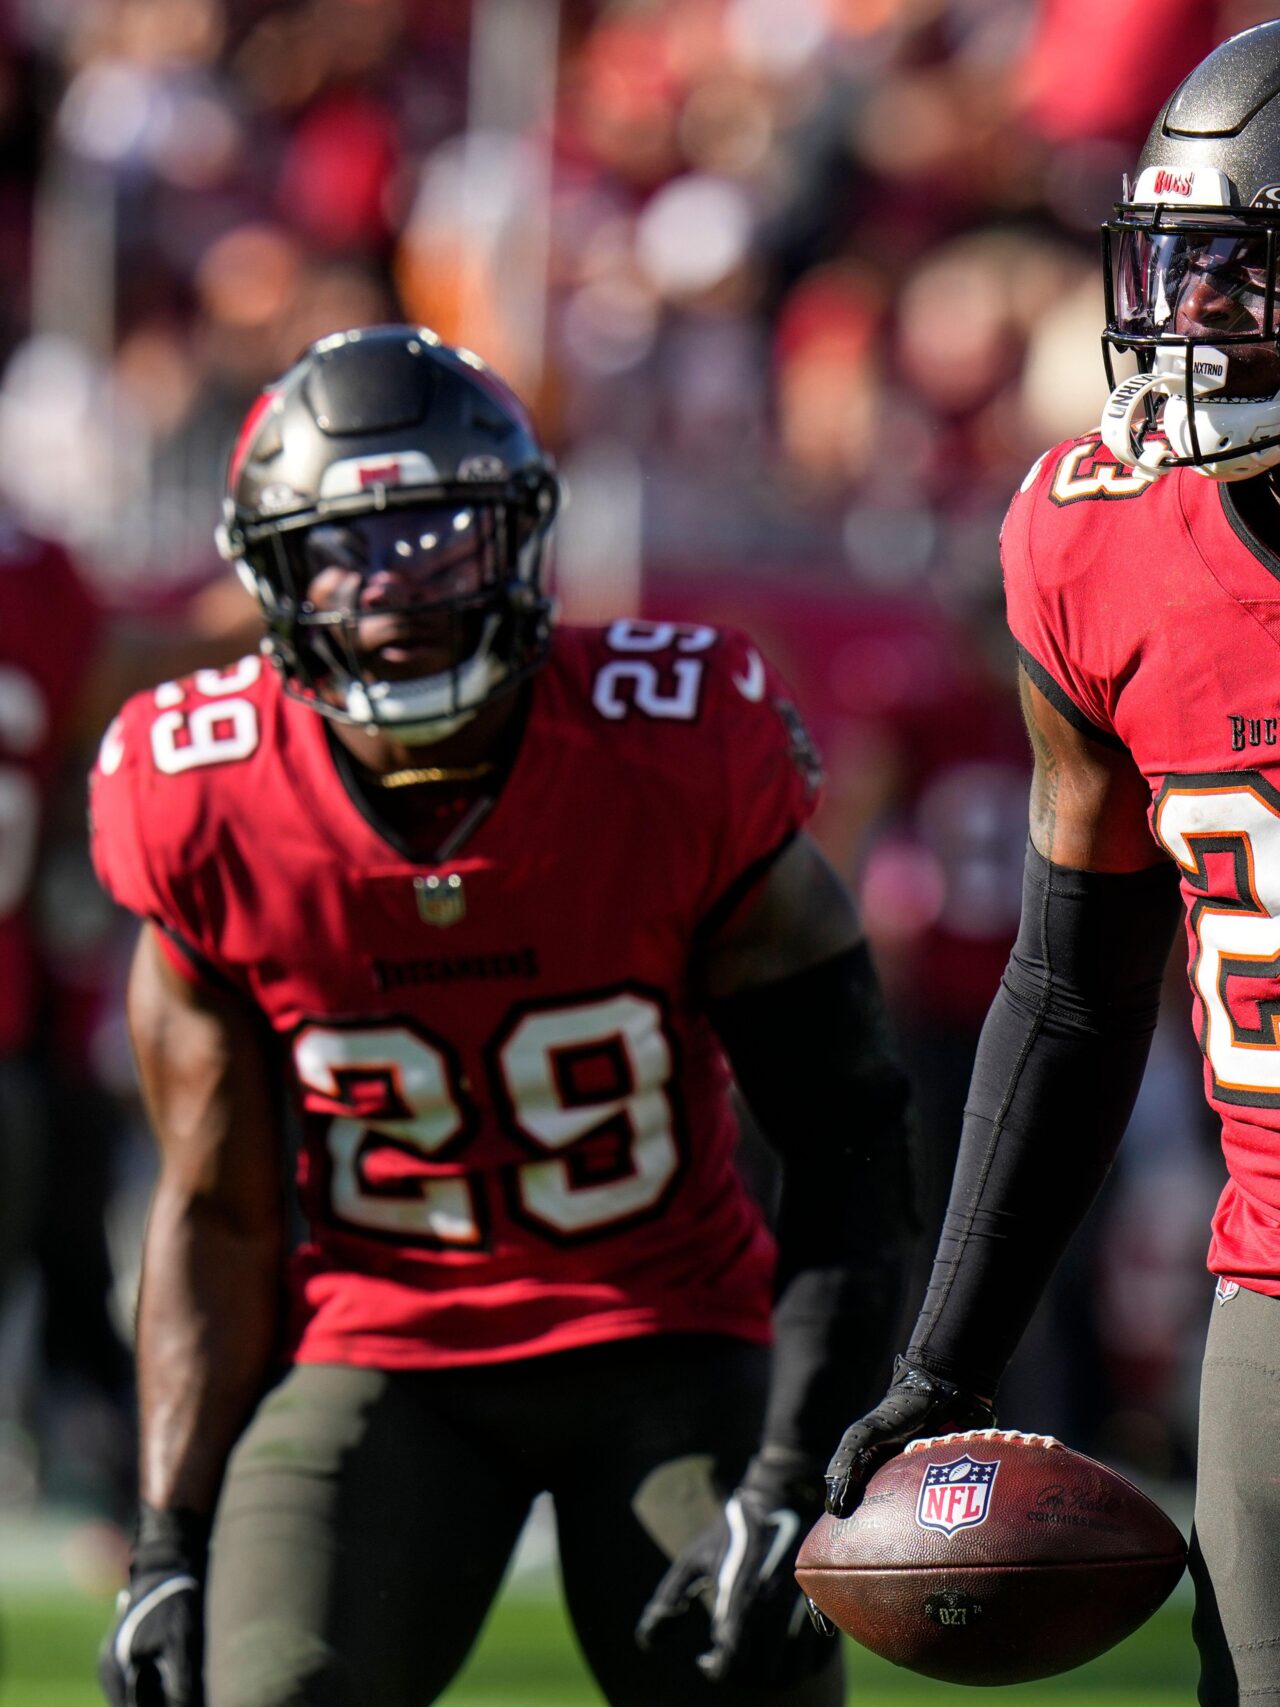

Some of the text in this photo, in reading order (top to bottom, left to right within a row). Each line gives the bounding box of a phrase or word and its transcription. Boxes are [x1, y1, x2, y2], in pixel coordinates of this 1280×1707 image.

[1193, 361, 1223, 377] NXTRND
[1107, 373, 1160, 419] XTRND
[290, 982, 690, 1253] 29
[924, 1485, 981, 1524] NFL
[939, 1608, 967, 1625] 027
